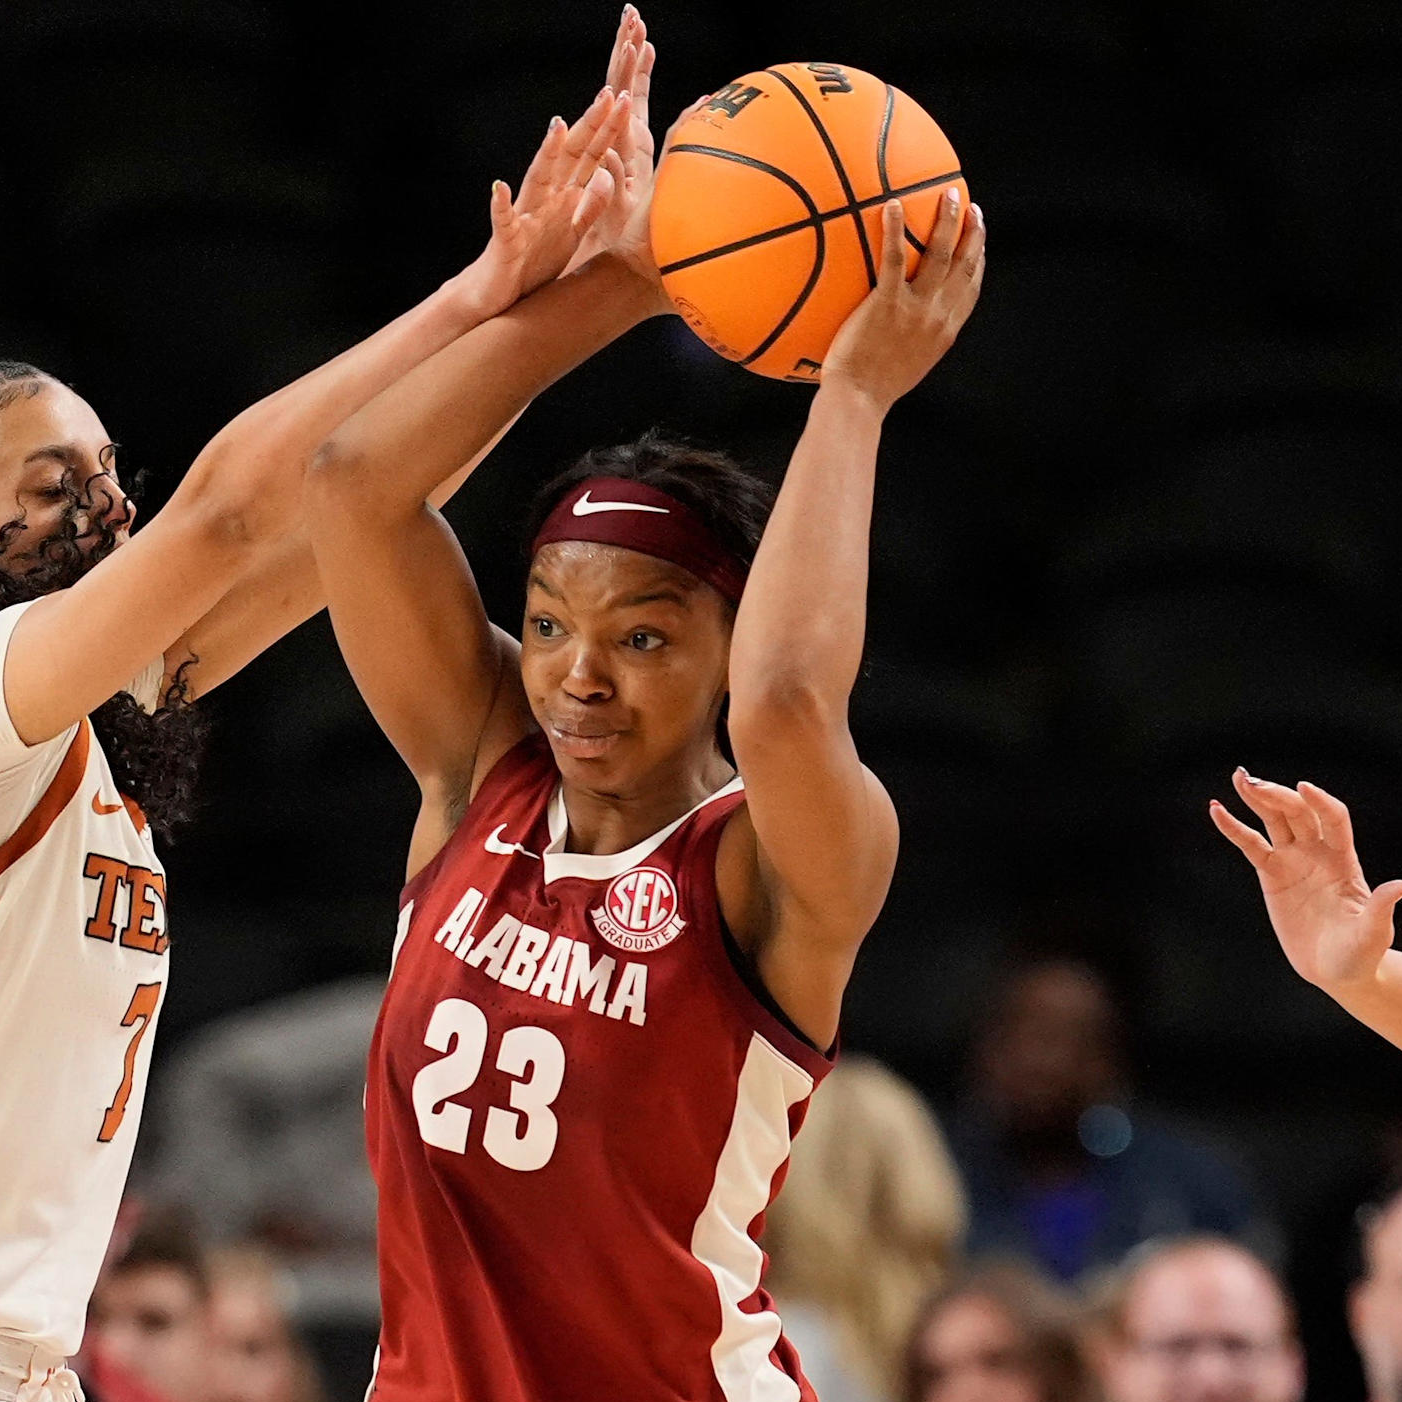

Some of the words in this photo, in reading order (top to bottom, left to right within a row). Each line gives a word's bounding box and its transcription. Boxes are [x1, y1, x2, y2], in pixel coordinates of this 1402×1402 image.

[434, 886, 649, 1026] ALABAMA
[598, 920, 673, 950] GRADUATE
[612, 872, 671, 930] SEC
[97, 981, 161, 1142] 7
[412, 998, 565, 1171] 23
